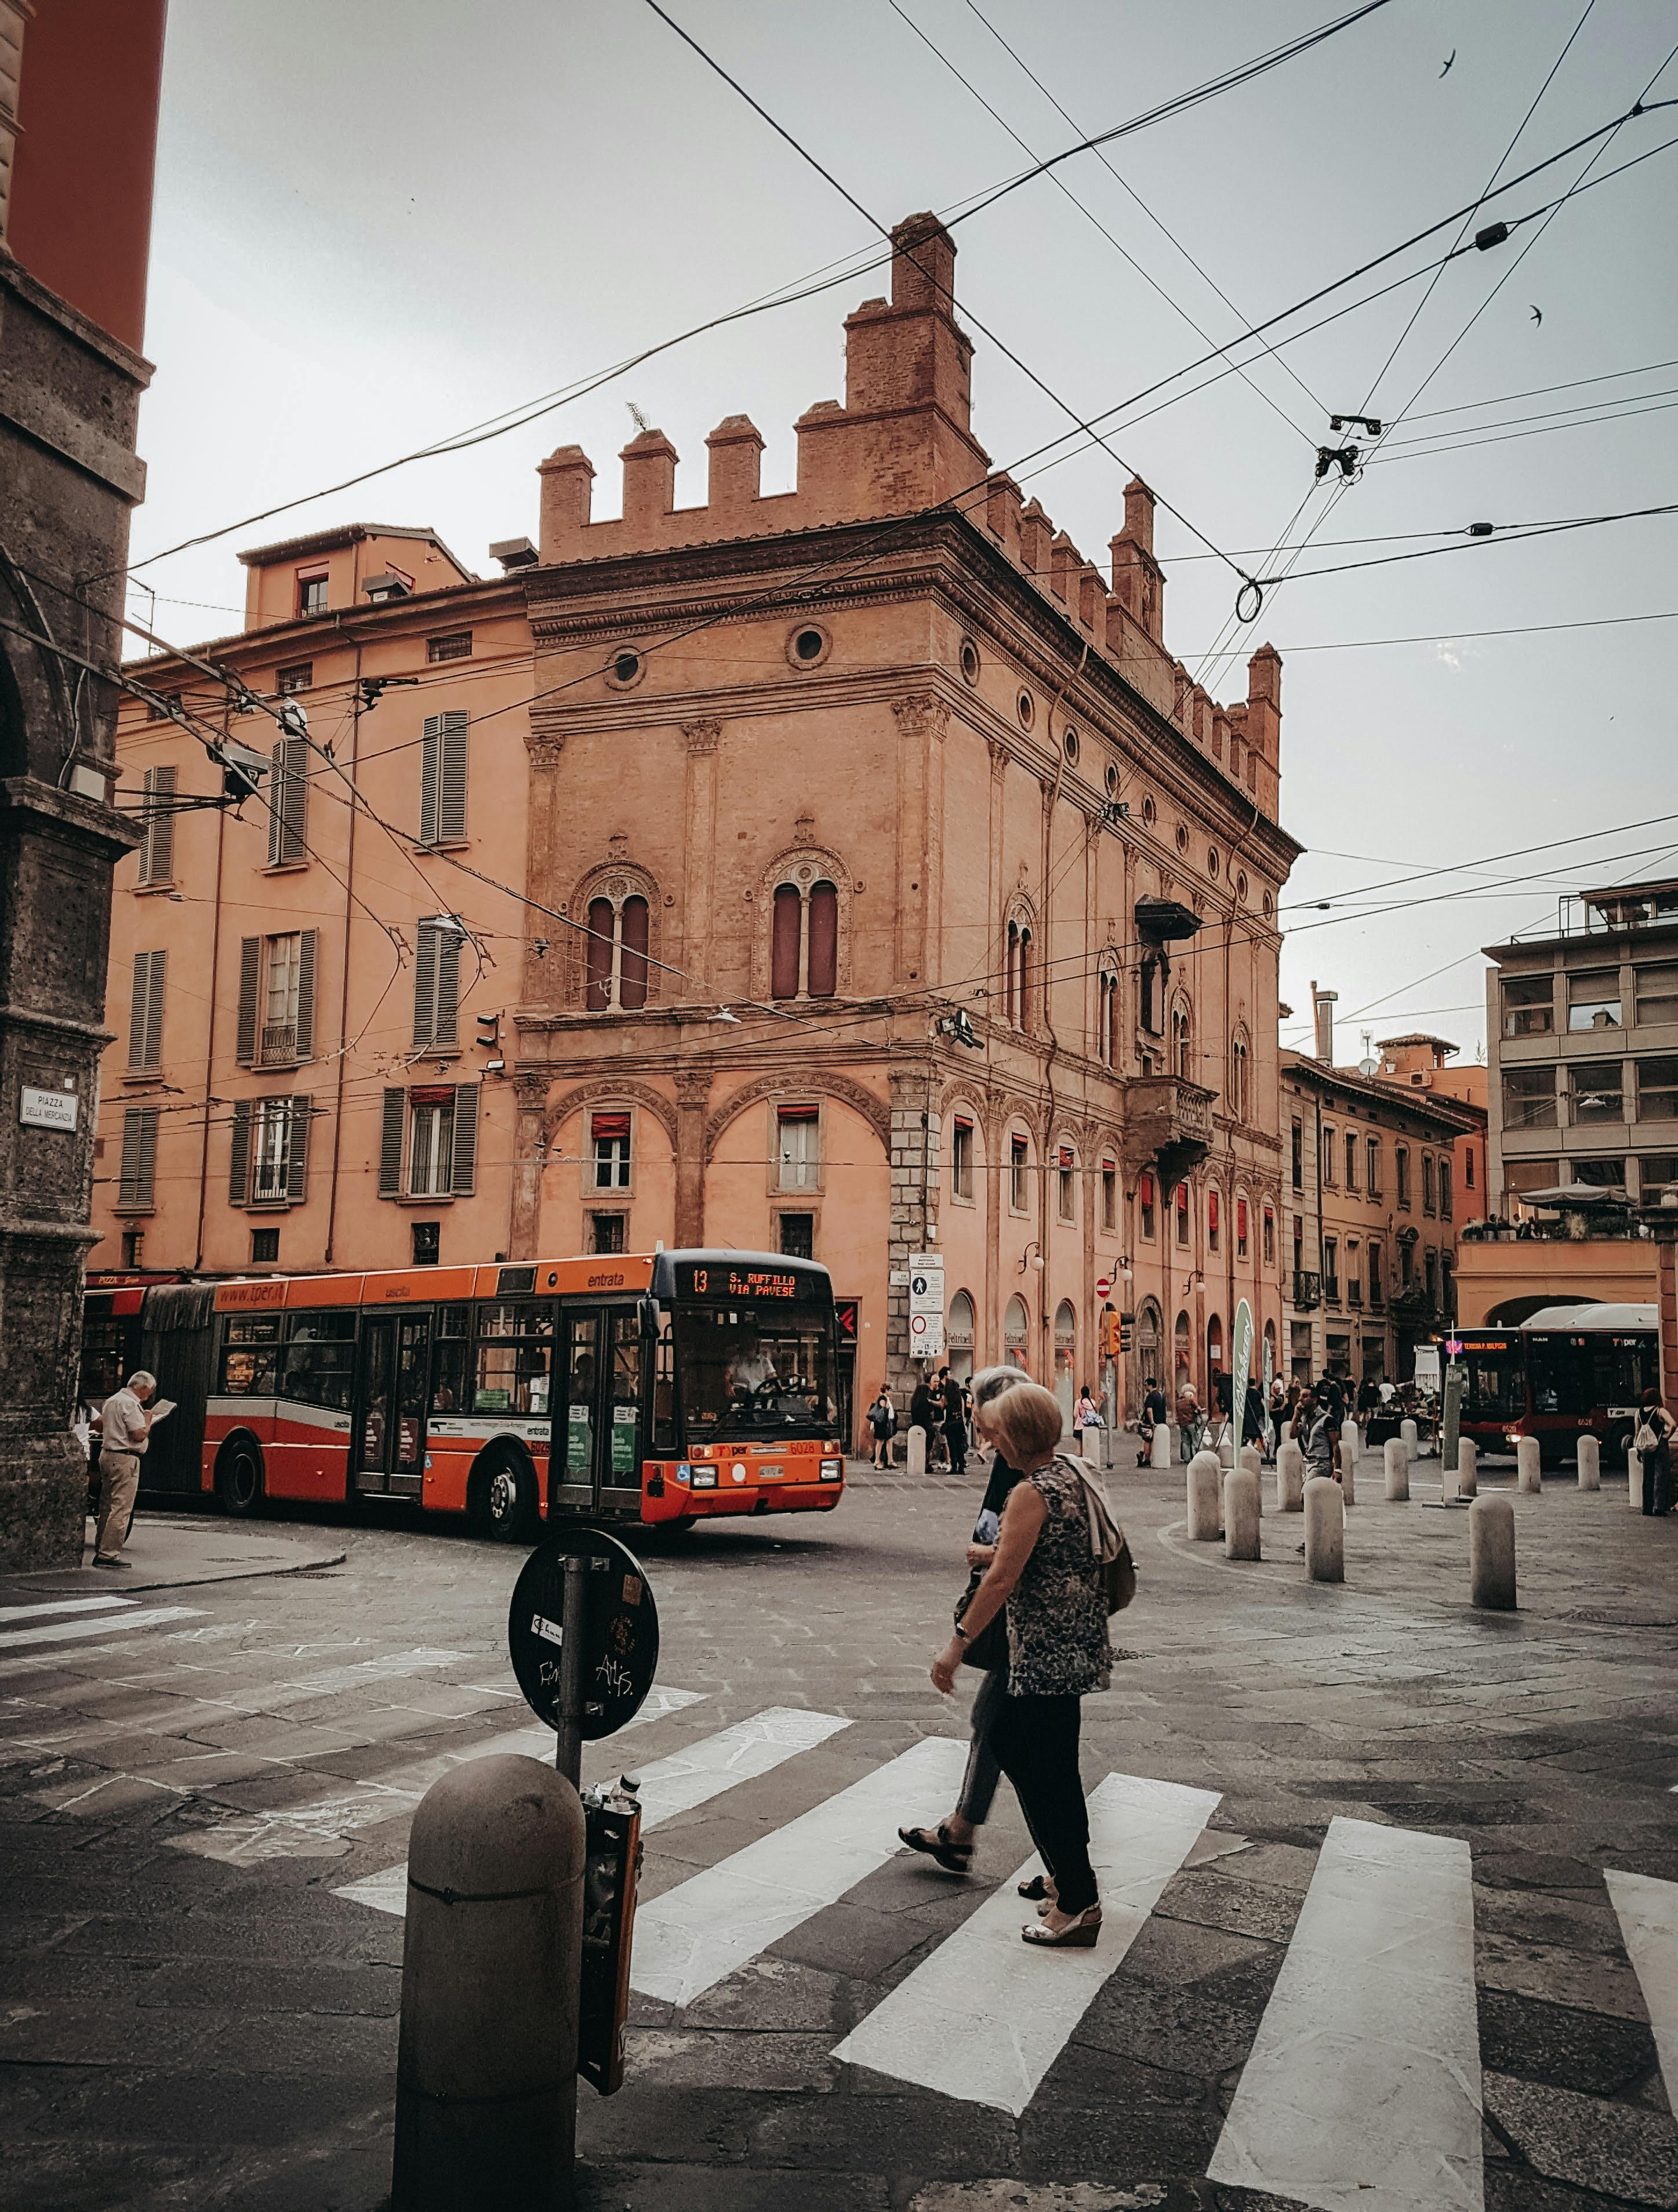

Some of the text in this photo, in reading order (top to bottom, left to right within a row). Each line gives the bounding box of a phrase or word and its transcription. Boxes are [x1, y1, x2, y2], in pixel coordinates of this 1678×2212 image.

[38, 1096, 63, 1108] PIAZZA
[26, 1107, 42, 1116] DELLA
[99, 1276, 118, 1285] PIZZA
[588, 1273, 624, 1287] entrata
[694, 1270, 708, 1292] 13
[729, 1272, 795, 1286] S. RUFFILLO
[729, 1284, 795, 1297] VIA PAVESE
[527, 1427, 549, 1435] entrata
